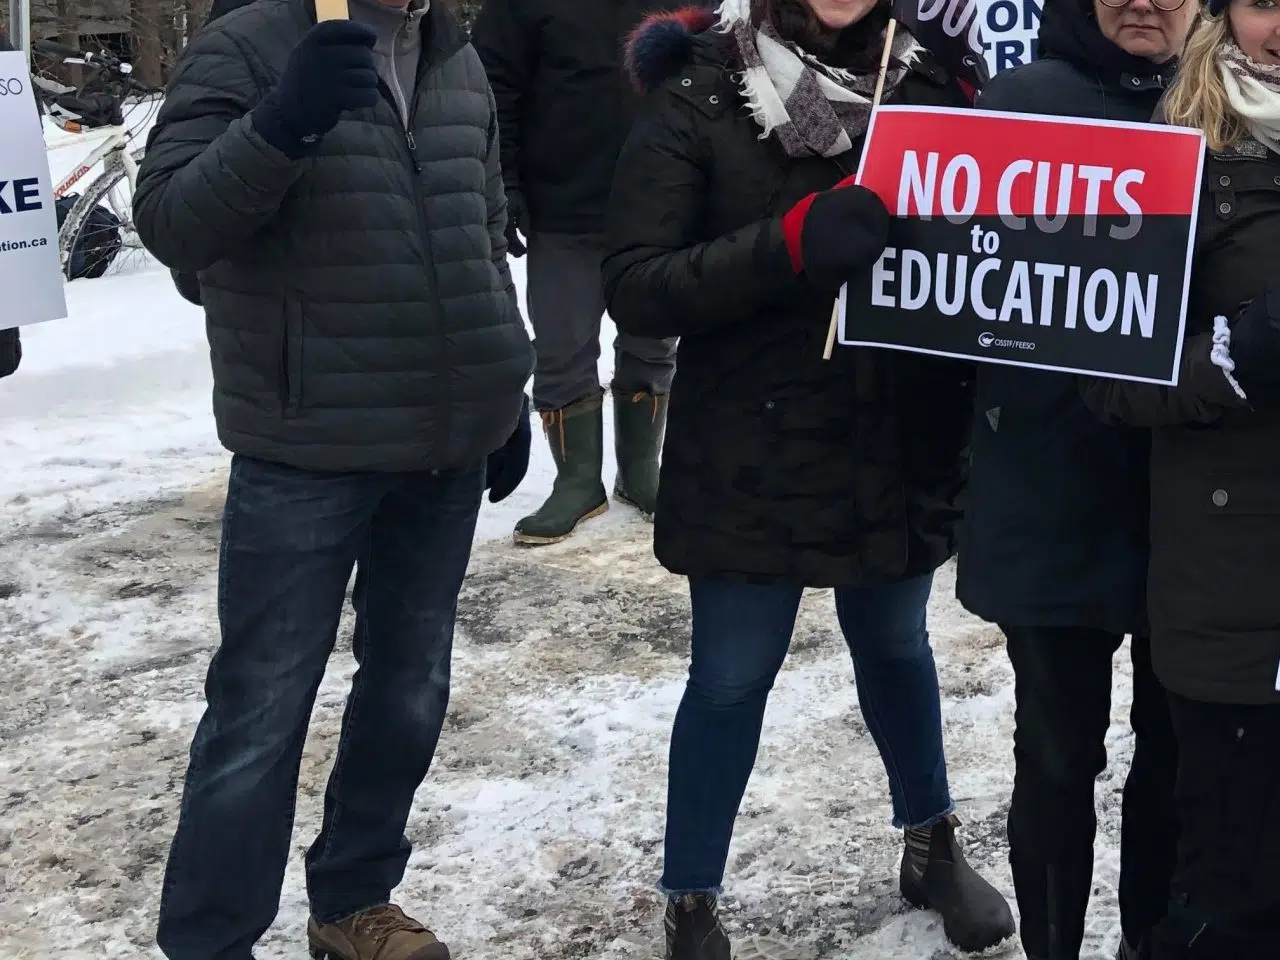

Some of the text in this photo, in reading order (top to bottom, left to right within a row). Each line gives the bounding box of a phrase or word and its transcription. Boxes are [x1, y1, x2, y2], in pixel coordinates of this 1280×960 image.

[896, 149, 1146, 241] NO CUTS
[970, 224, 1000, 255] to
[871, 246, 1159, 339] EDUCATION
